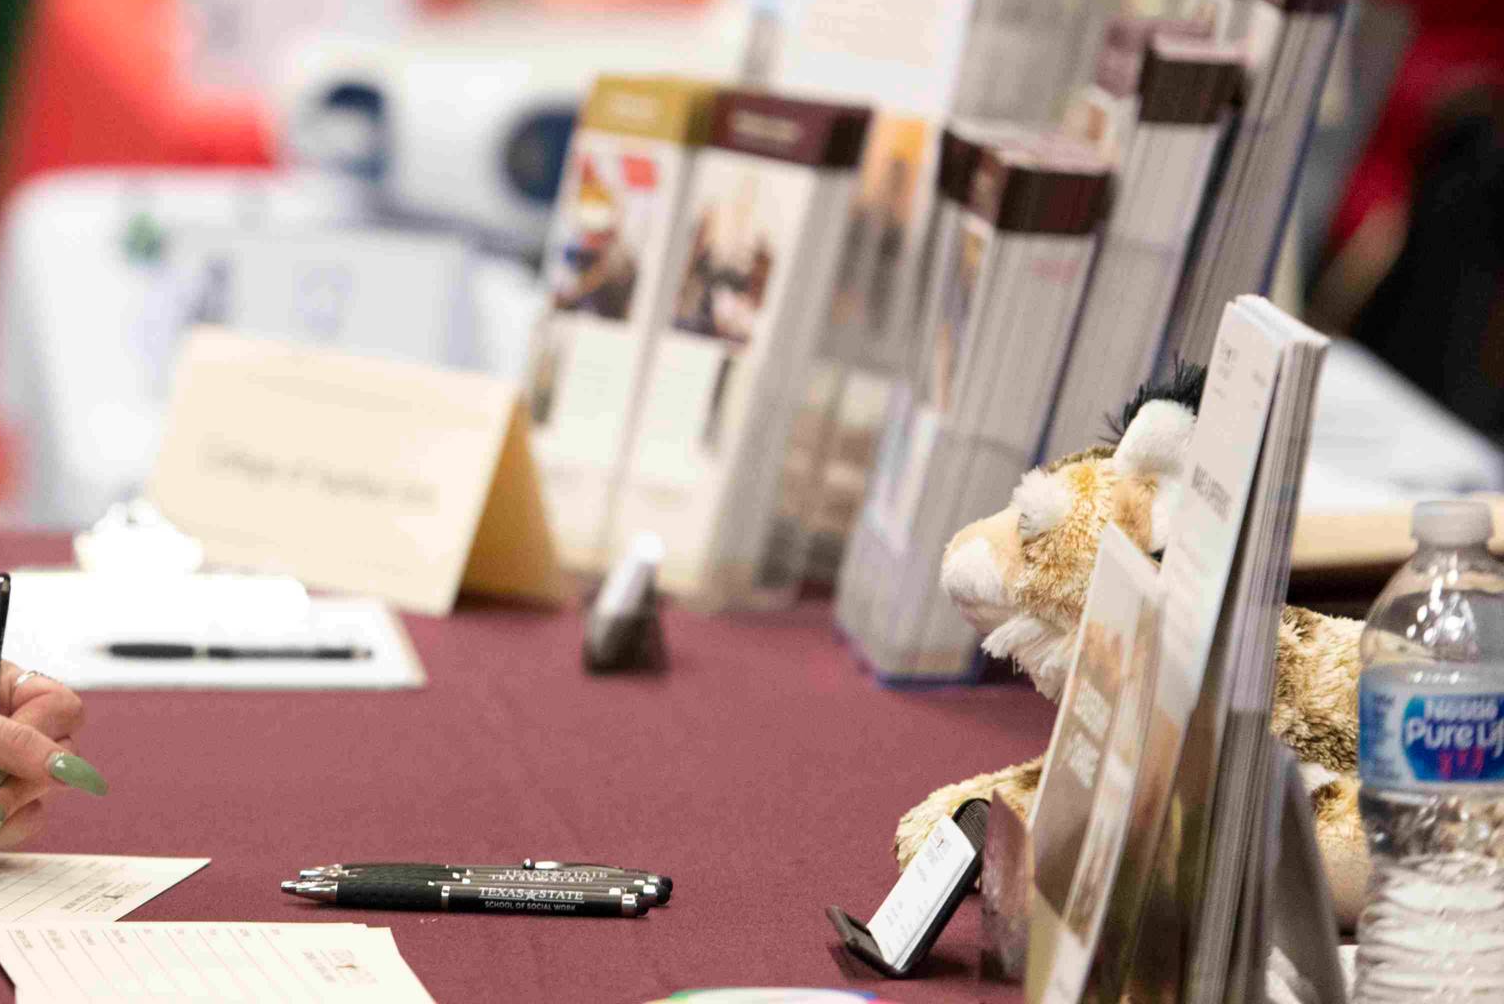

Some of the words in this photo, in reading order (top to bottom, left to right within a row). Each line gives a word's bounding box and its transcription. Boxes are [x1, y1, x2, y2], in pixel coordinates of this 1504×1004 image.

[1406, 717, 1474, 750] Pure
[478, 886, 523, 898] TEXAS
[538, 890, 584, 901] STATE
[484, 900, 514, 909] SCHOOL
[516, 901, 525, 909] OF
[526, 902, 552, 910] SOCIAL
